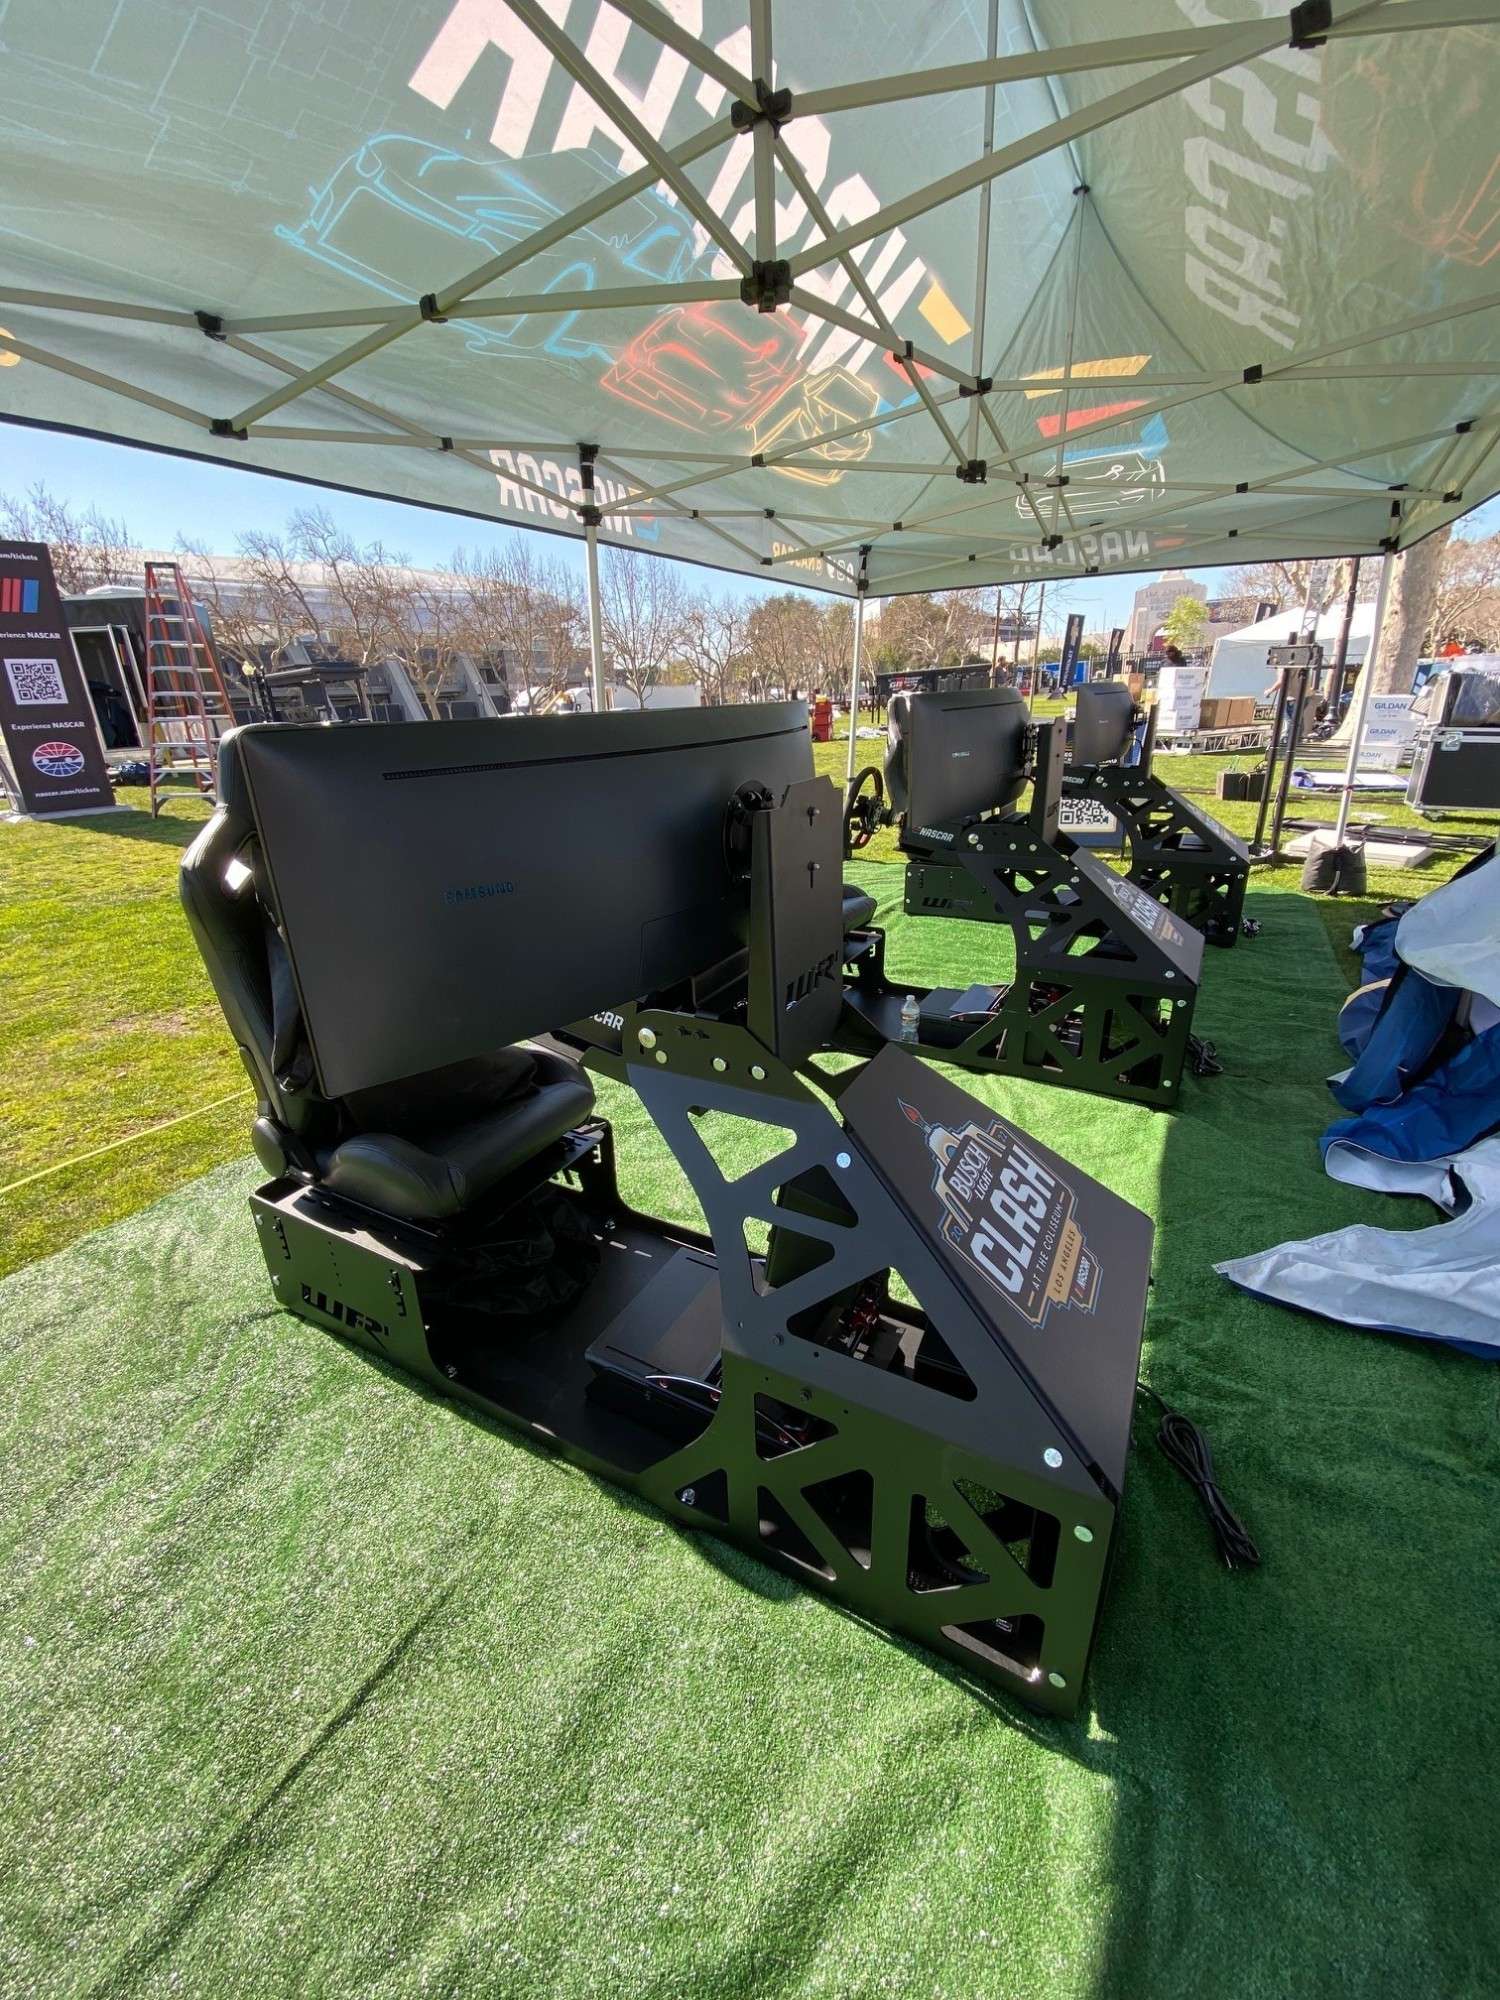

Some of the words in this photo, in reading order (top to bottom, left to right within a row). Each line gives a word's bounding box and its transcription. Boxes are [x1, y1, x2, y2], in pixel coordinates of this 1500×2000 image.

[26, 631, 61, 640] NASCAR
[1374, 702, 1407, 710] GILDAN
[11, 723, 51, 731] Experience
[52, 721, 85, 729] NASCAR
[919, 827, 954, 842] NASCAR
[590, 1010, 625, 1031] CAR
[949, 1140, 990, 1202] BUSCH
[970, 1144, 1056, 1293] CLASH
[1042, 1203, 1065, 1250] COLISEUM
[1036, 1251, 1049, 1273] THE
[1053, 1272, 1065, 1294] LOS
[1061, 1229, 1076, 1271] ANGELES
[1031, 1273, 1042, 1291] AT
